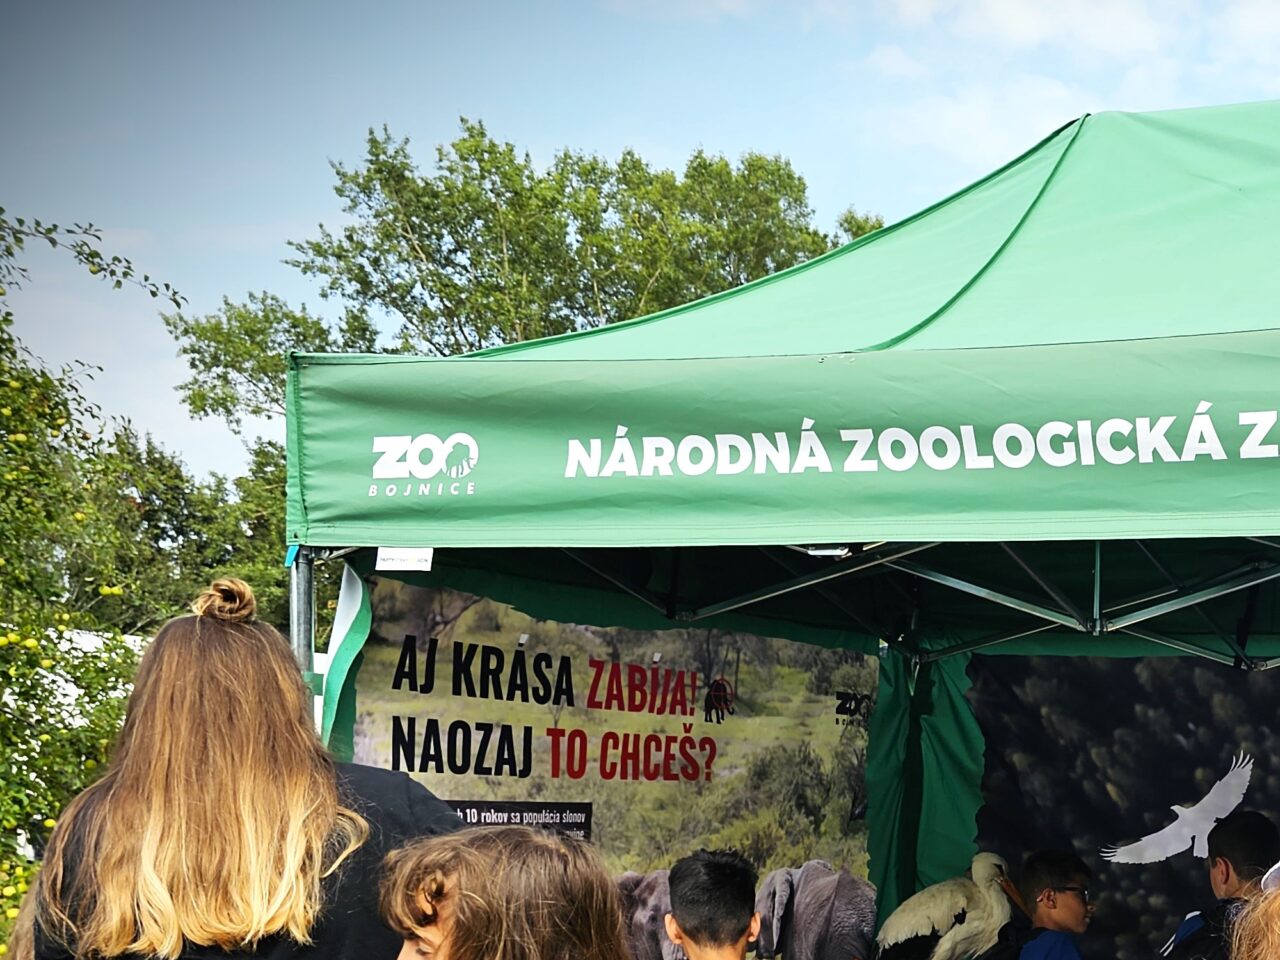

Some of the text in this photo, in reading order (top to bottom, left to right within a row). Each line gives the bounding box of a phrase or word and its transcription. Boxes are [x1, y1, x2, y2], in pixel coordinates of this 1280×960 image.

[372, 432, 479, 480] ZOO
[564, 417, 833, 478] NÁRODNÁ
[839, 400, 1228, 473] ZOOLOGICKÁ
[368, 482, 475, 497] BOJNICE
[392, 634, 697, 716] AJ KRÁSA ZABÍJA!
[391, 715, 717, 782] NAOZAJ TO CHCEŠ?
[465, 808, 478, 823] 10
[480, 809, 508, 823] rokov
[511, 812, 520, 824] sa
[523, 810, 560, 826] populácia
[562, 810, 586, 823] slonov
